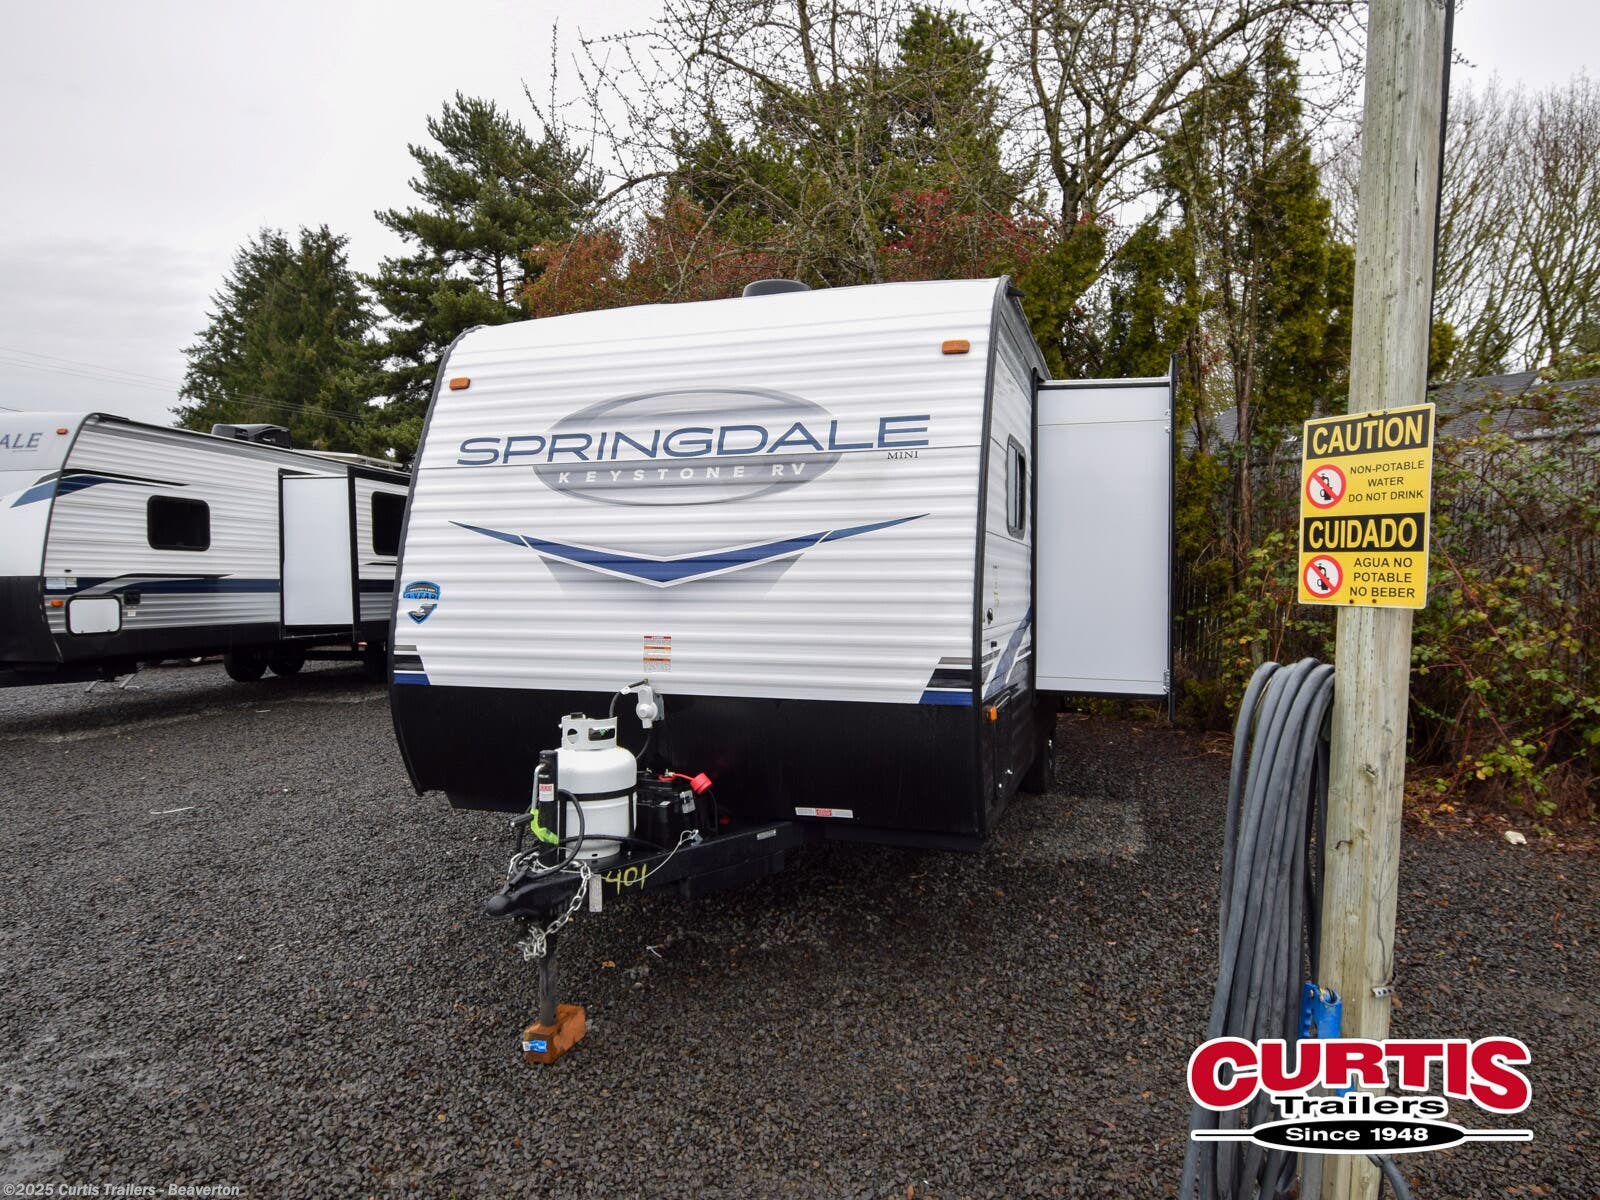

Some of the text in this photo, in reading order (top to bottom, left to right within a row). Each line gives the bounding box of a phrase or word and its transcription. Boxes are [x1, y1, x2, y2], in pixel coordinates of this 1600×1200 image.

[457, 414, 930, 466] SPRINGDALE
[1312, 414, 1423, 456] CAUTION
[887, 450, 919, 460] MINI
[558, 462, 806, 484] KEYSTONE RV
[1350, 460, 1425, 475] NON-POTABLE
[1367, 476, 1404, 488] WATER
[1348, 489, 1424, 503] DO NOT DRINK
[1309, 517, 1418, 550] CUIDADO
[1353, 557, 1413, 568] AGUA NO
[1353, 572, 1413, 584] POTABLE
[1349, 586, 1416, 599] NO BEBER
[605, 863, 647, 895] 401
